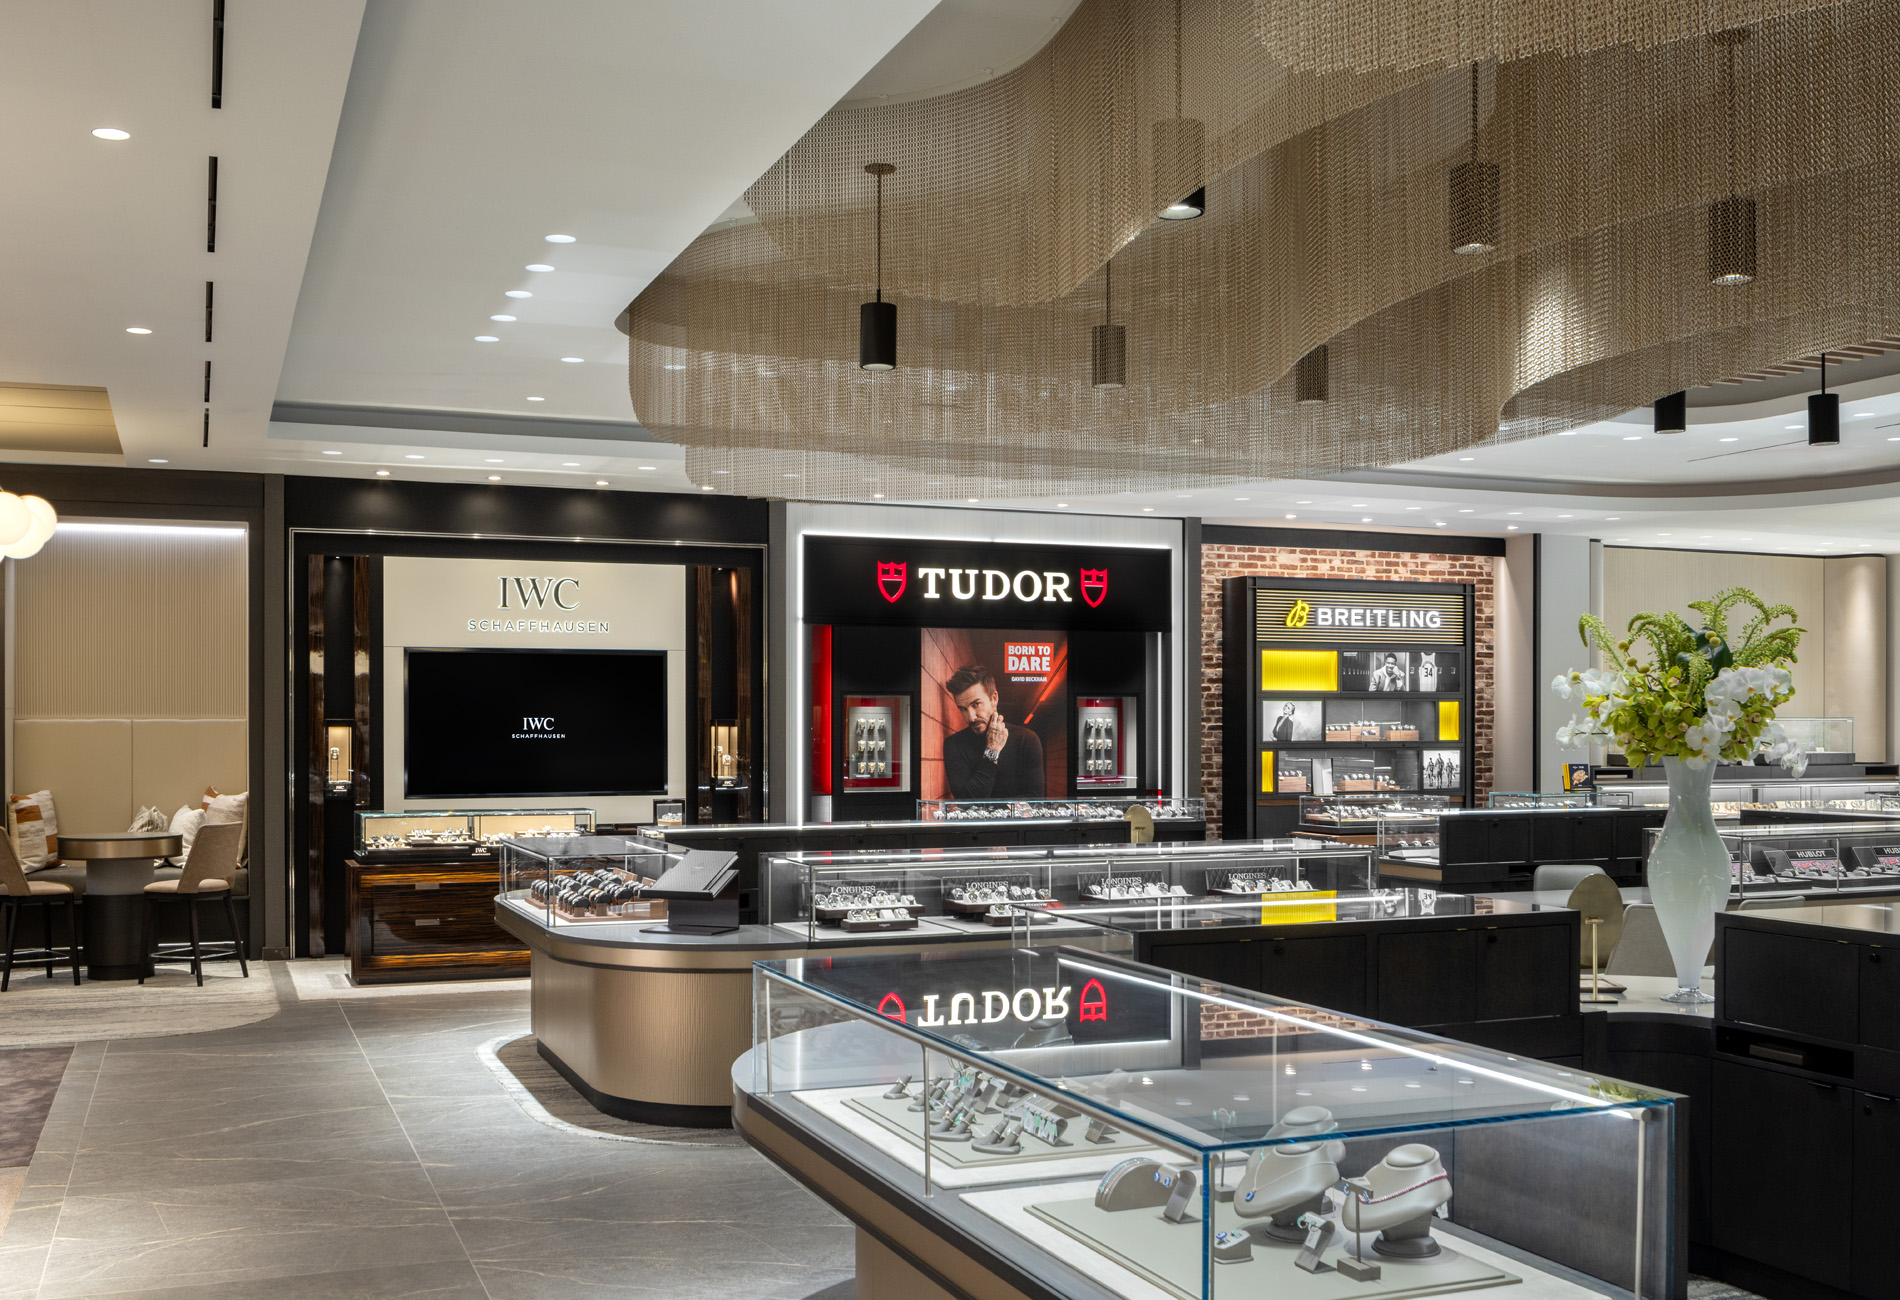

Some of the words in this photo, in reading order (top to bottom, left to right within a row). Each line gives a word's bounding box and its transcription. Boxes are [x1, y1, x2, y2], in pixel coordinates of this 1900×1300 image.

[918, 568, 1072, 602] TUDOR
[498, 577, 580, 611] IWC
[1317, 608, 1441, 628] BREITLING
[468, 620, 609, 633] SCHAFFHAUSEN
[1008, 645, 1035, 655] BORN
[1037, 645, 1051, 655] TO
[1008, 656, 1051, 671] DARE
[1424, 667, 1432, 677] 34
[522, 717, 555, 730] IWC
[1796, 850, 1826, 858] HUBLOT
[1101, 876, 1142, 885] LONGINES
[1228, 872, 1267, 880] LONGINES
[831, 885, 876, 894] LONGINES
[965, 880, 1009, 889] LONGINES
